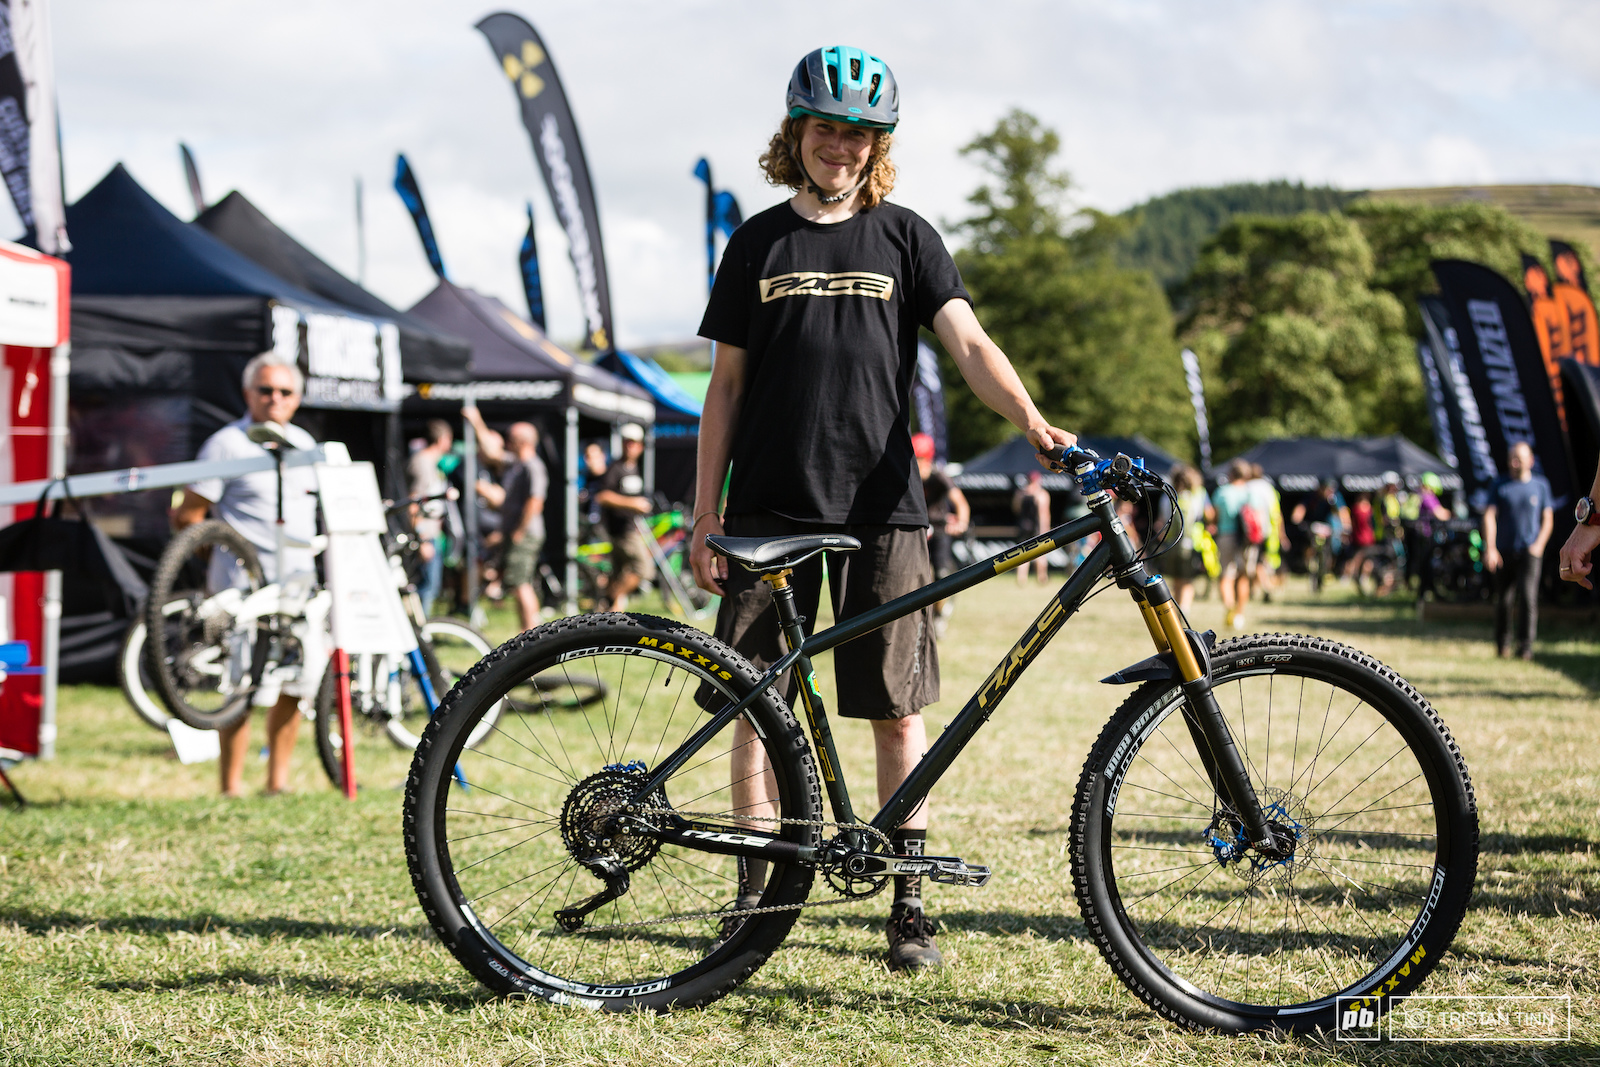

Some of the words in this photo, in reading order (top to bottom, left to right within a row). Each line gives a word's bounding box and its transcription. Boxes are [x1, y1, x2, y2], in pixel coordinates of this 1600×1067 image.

[1467, 298, 1539, 453] ECIALIZED
[637, 636, 733, 681] MAXXIS
[1236, 657, 1255, 667] EXO
[1104, 733, 1132, 779] HIGH
[1349, 944, 1426, 1011] MAXXIS
